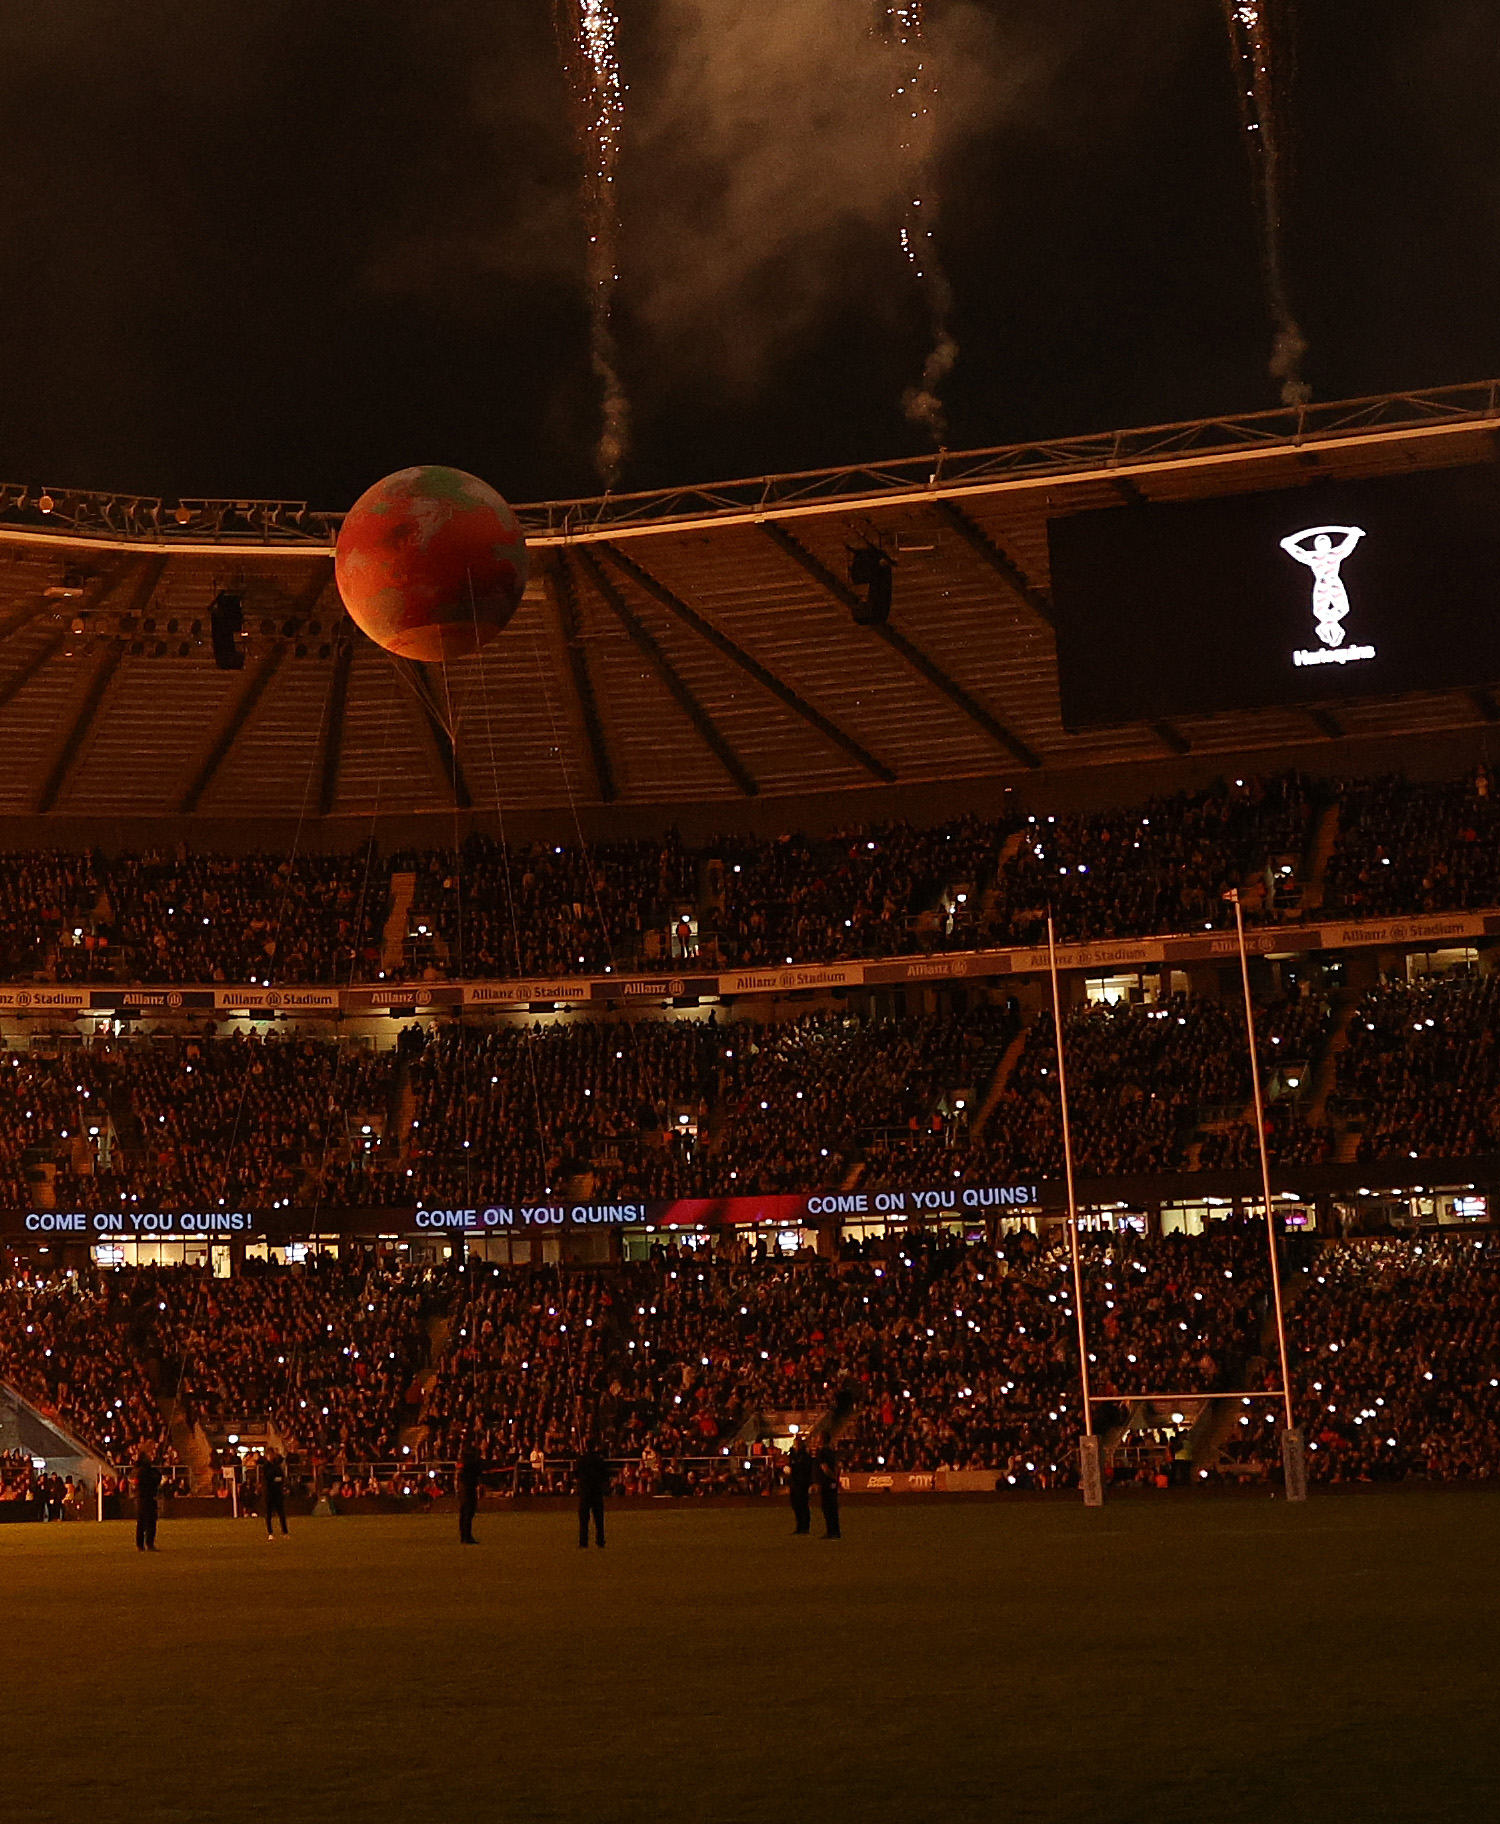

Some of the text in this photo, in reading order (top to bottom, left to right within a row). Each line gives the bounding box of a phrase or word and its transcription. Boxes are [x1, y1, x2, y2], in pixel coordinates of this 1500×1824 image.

[1342, 924, 1464, 942] Allianz Stadium
[1094, 948, 1146, 962] Stadium
[907, 963, 950, 976] Allianz
[736, 971, 845, 989] Allianz Stadium
[471, 985, 584, 1000] Allianz Stadium
[624, 981, 667, 994] Allianz
[34, 992, 83, 1005] Stadium
[123, 992, 165, 1006] Allianz
[223, 993, 333, 1005] Allianz Stadium
[371, 990, 414, 1004] Allianz
[807, 1185, 1038, 1214] COME ON YOU QUINS!
[25, 1213, 253, 1231] COME ON YOU QUINS!
[415, 1204, 646, 1228] COME ON YOU QUINS!
